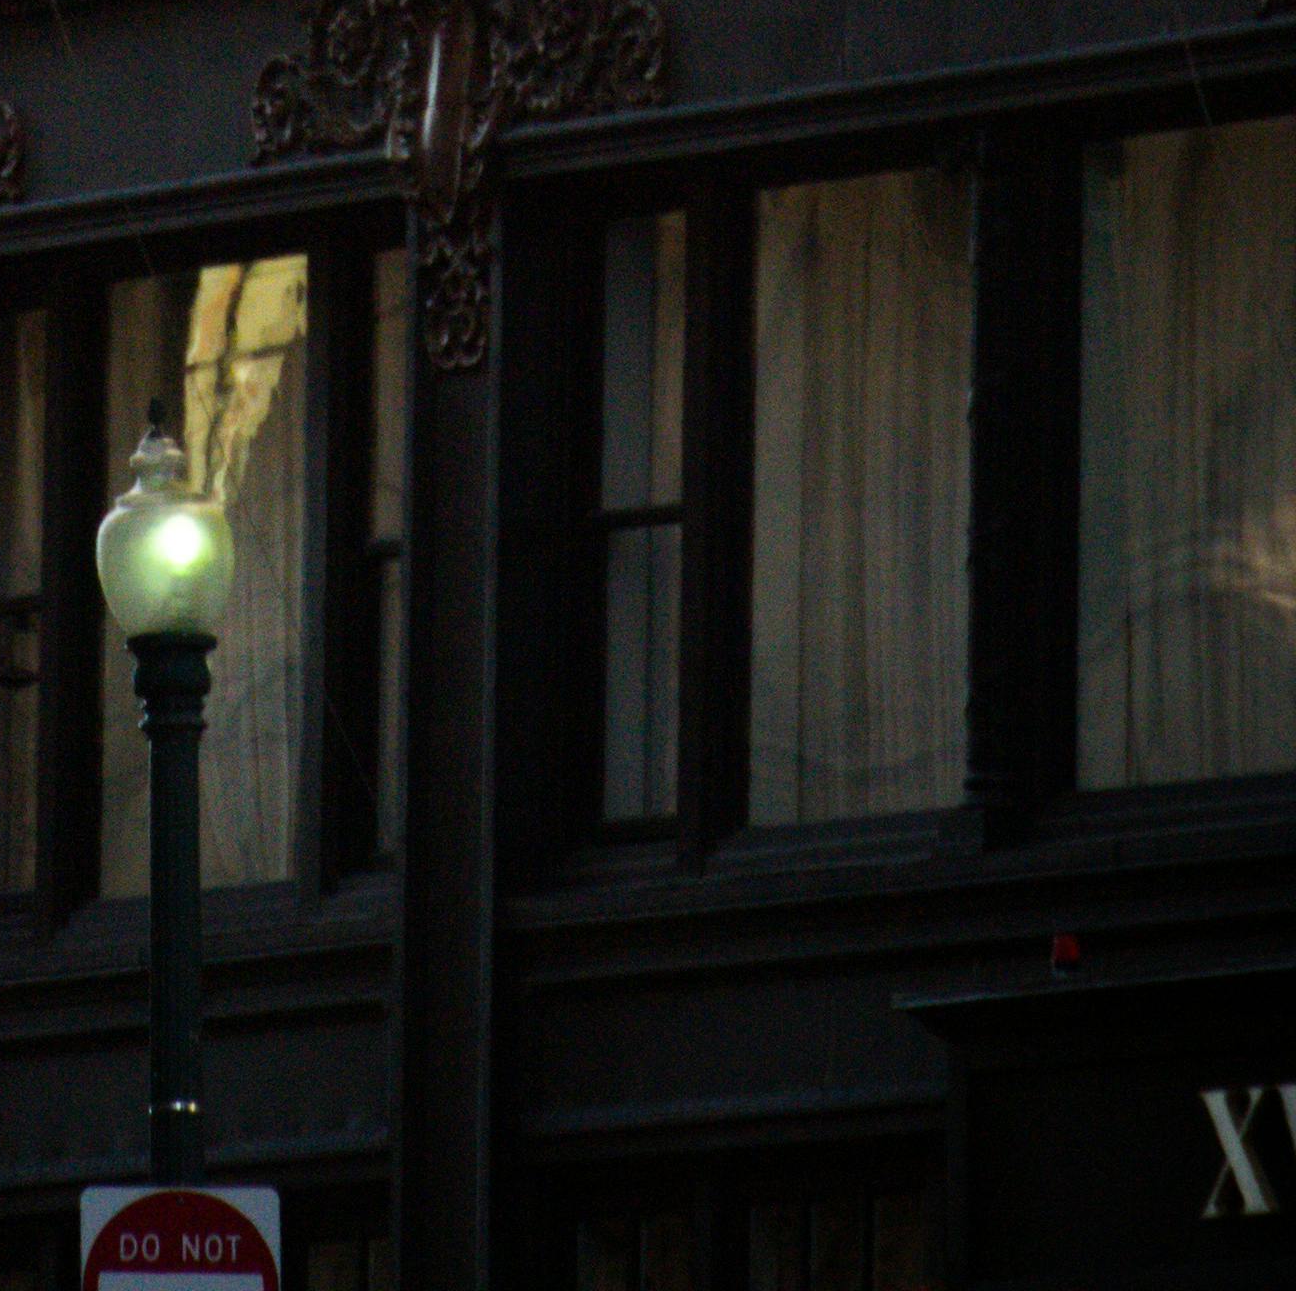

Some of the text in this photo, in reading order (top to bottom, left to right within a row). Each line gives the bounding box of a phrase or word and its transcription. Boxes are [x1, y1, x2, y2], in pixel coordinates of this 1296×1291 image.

[1197, 1084, 1296, 1219] X
[119, 1230, 242, 1265] DO NOT
